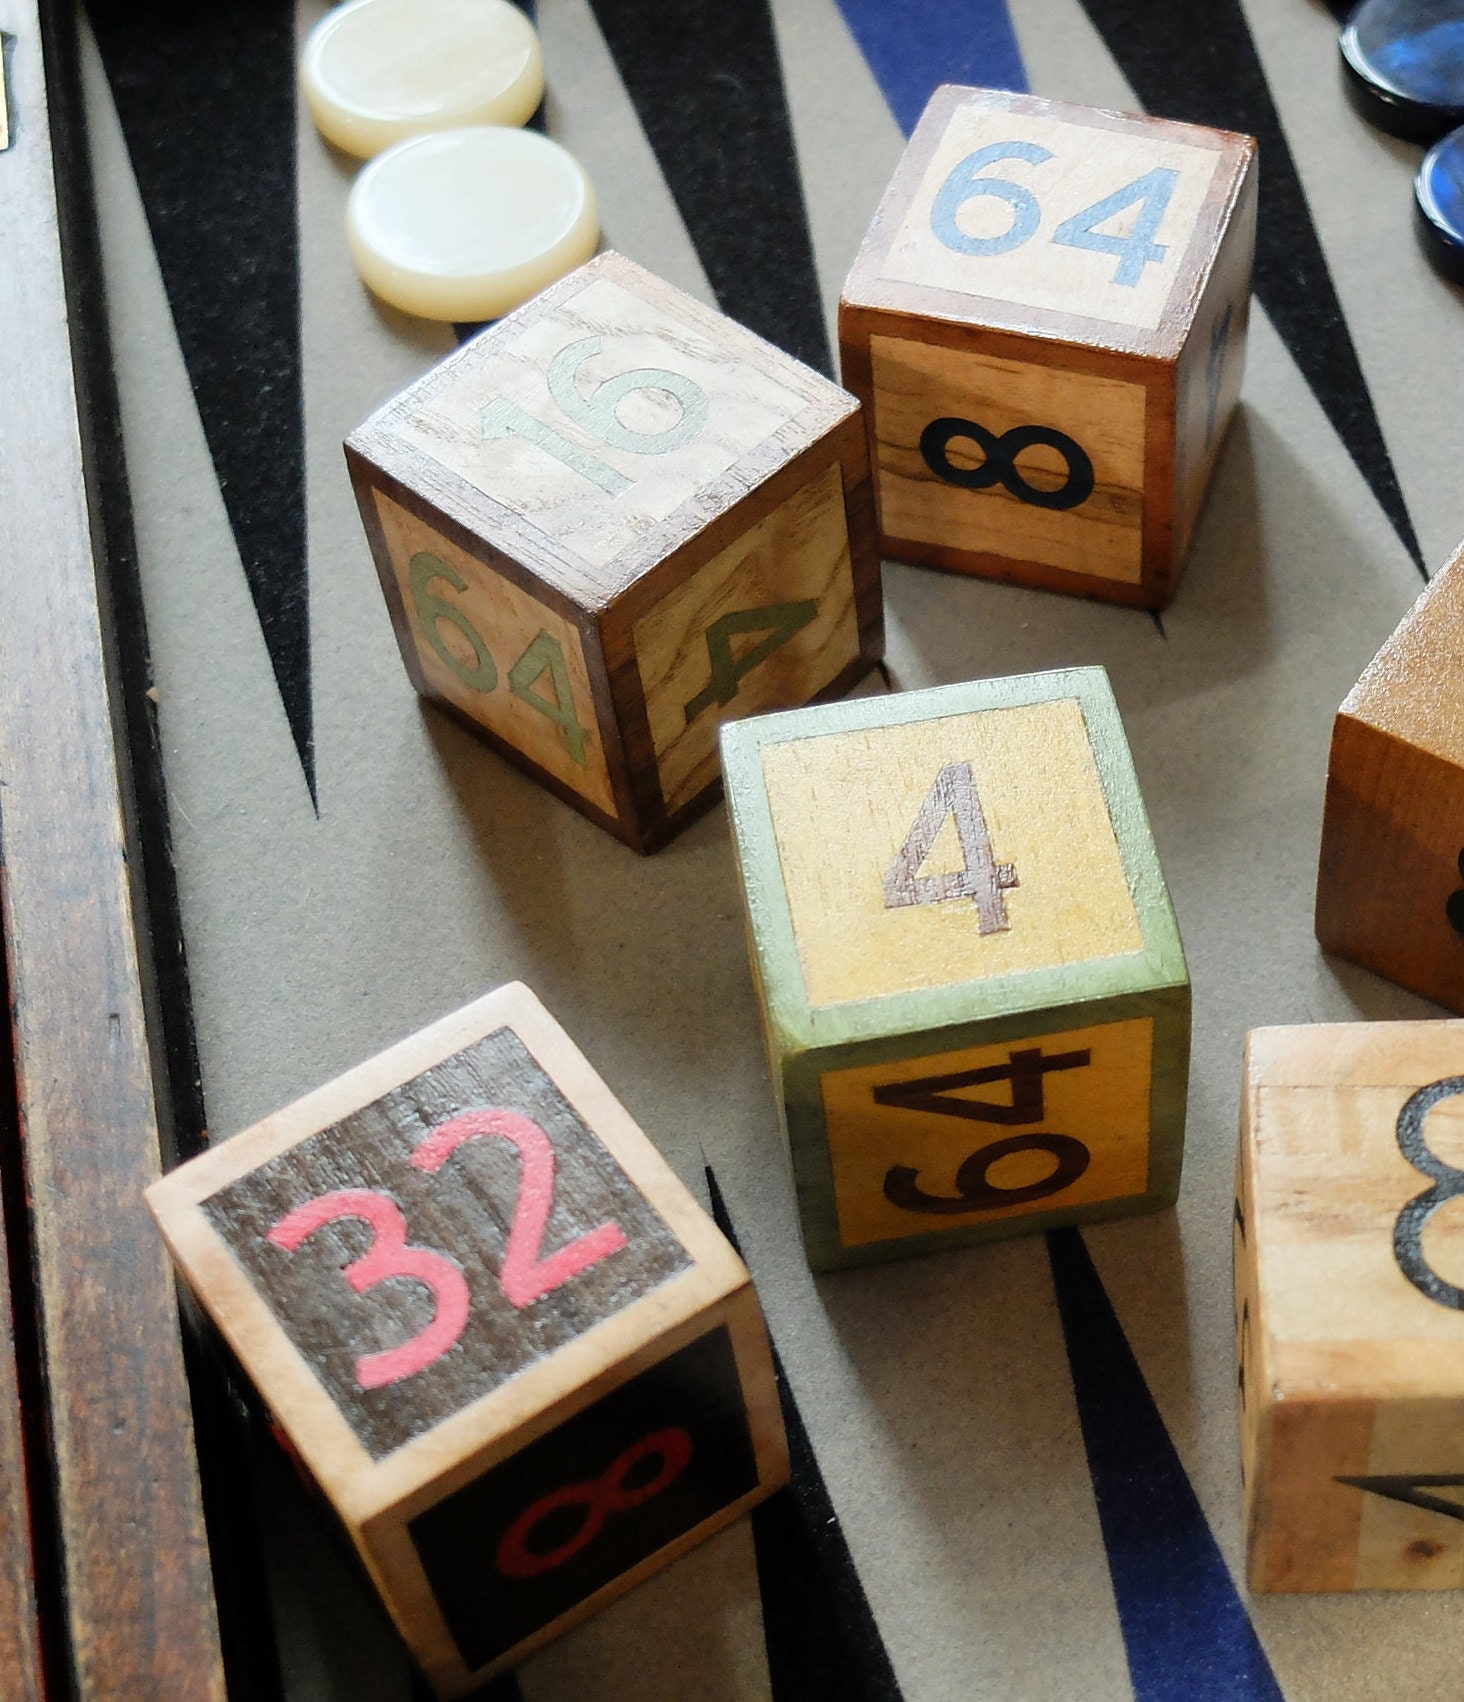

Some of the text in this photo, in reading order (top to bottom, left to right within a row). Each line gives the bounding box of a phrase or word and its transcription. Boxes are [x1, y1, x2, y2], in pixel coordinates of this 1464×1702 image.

[931, 141, 1181, 288] 64
[480, 335, 708, 498] 16
[920, 417, 1094, 511] 8
[409, 552, 593, 768] 64
[684, 598, 819, 725] 4
[883, 761, 1020, 936] 4
[873, 1048, 1092, 1214] 64
[267, 1107, 628, 1391] 32
[498, 1426, 693, 1579] 8
